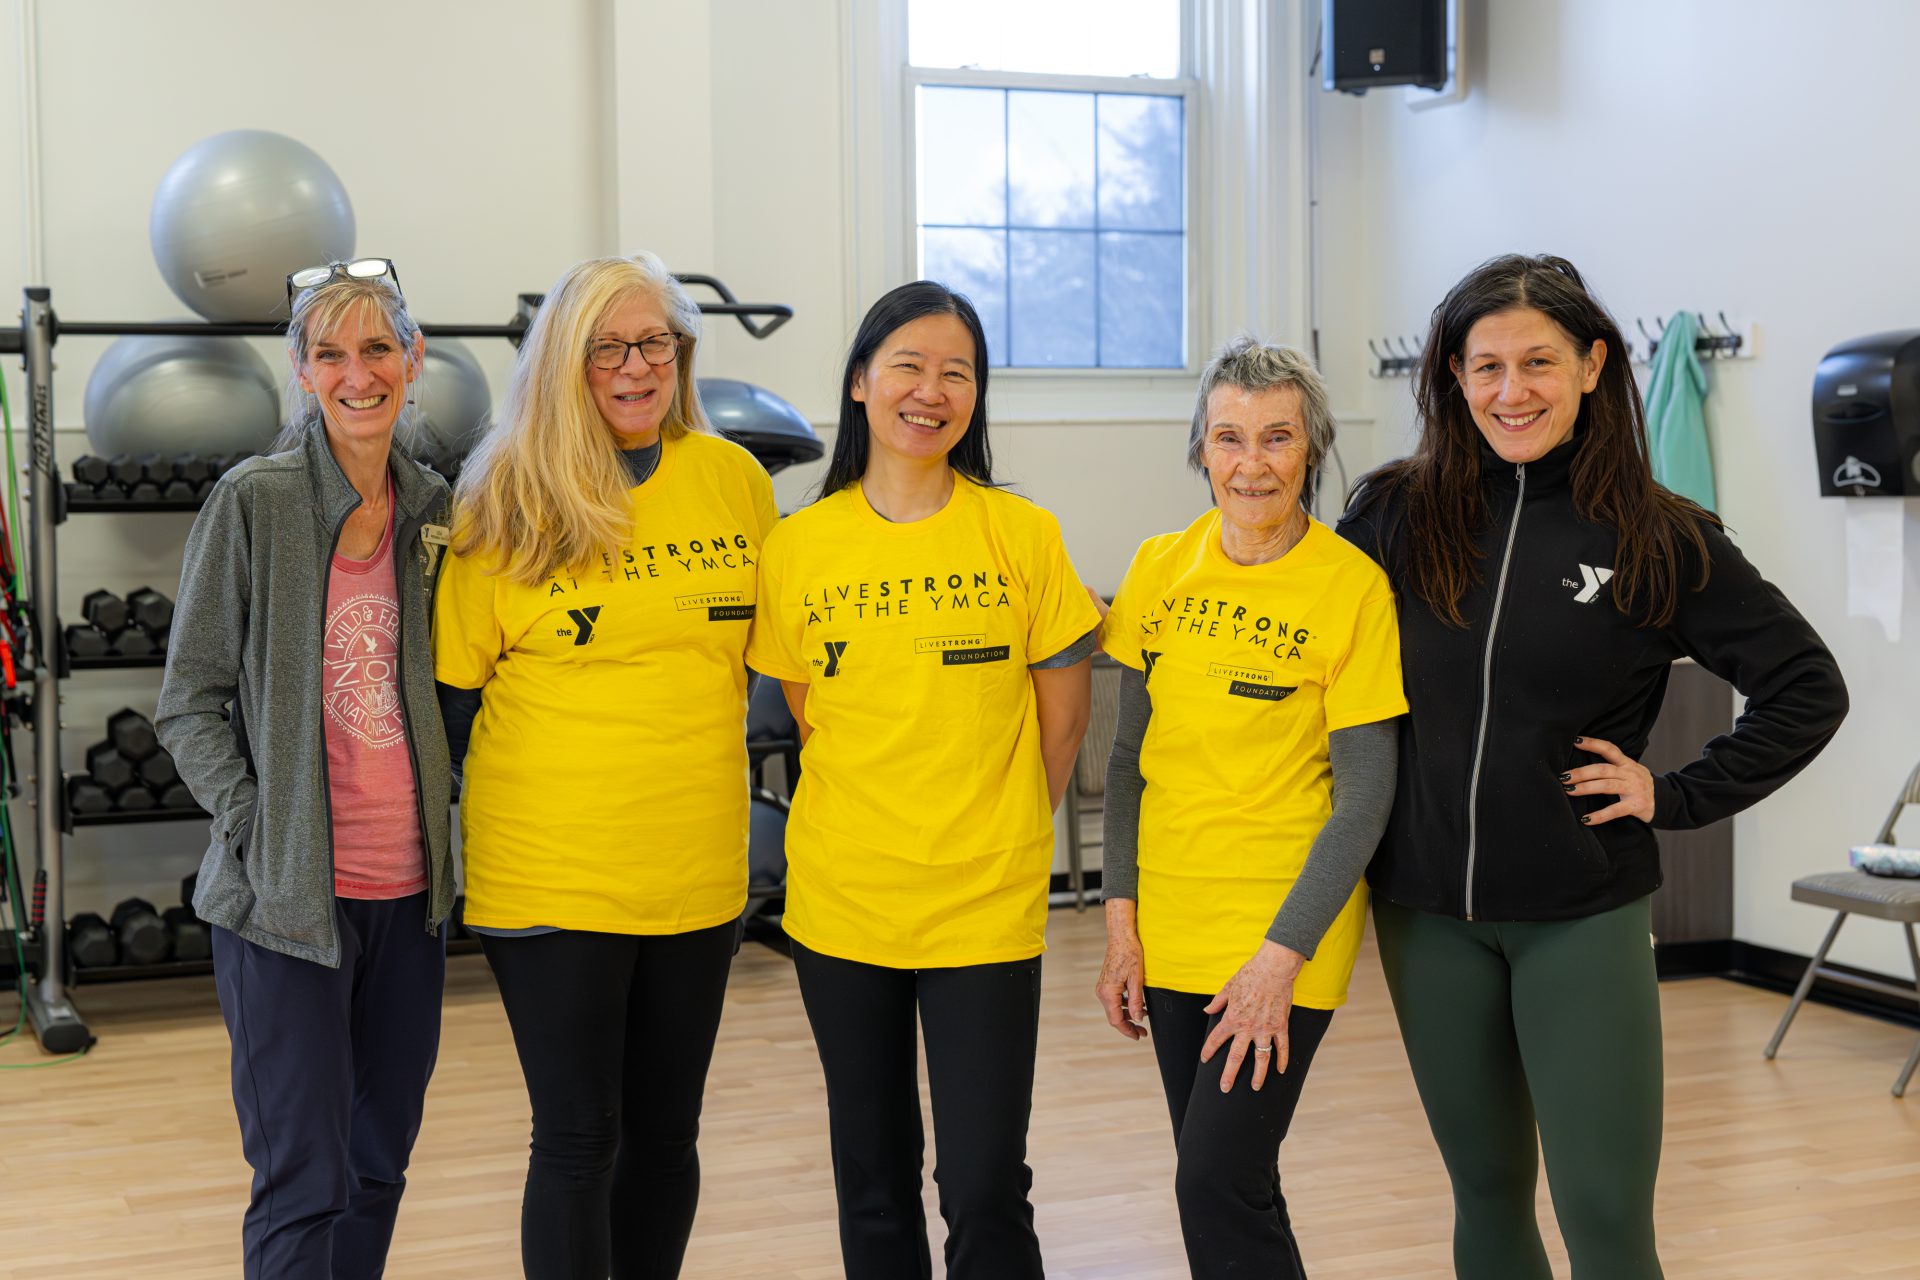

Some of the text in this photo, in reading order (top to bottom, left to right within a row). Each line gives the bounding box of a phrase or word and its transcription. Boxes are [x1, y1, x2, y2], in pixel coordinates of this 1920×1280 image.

[678, 553, 755, 573] YMCA
[681, 595, 742, 606] LIVESTRONG
[1562, 563, 1615, 604] the Y
[327, 610, 362, 649] WILD
[362, 604, 374, 622] &
[556, 605, 602, 646] the Y
[713, 608, 755, 618] FOUNDATIO
[807, 591, 1011, 626] AT THE YMCA
[1141, 596, 1310, 646] VESTRONG
[919, 637, 983, 649] LIVESTRONG
[948, 650, 1005, 662] FOUNDATION
[1176, 616, 1220, 638] THE
[1233, 623, 1302, 660] YMCA
[812, 641, 848, 678] the Y
[1213, 667, 1270, 682] LIVESTRONG
[337, 695, 397, 737] NATIONAL
